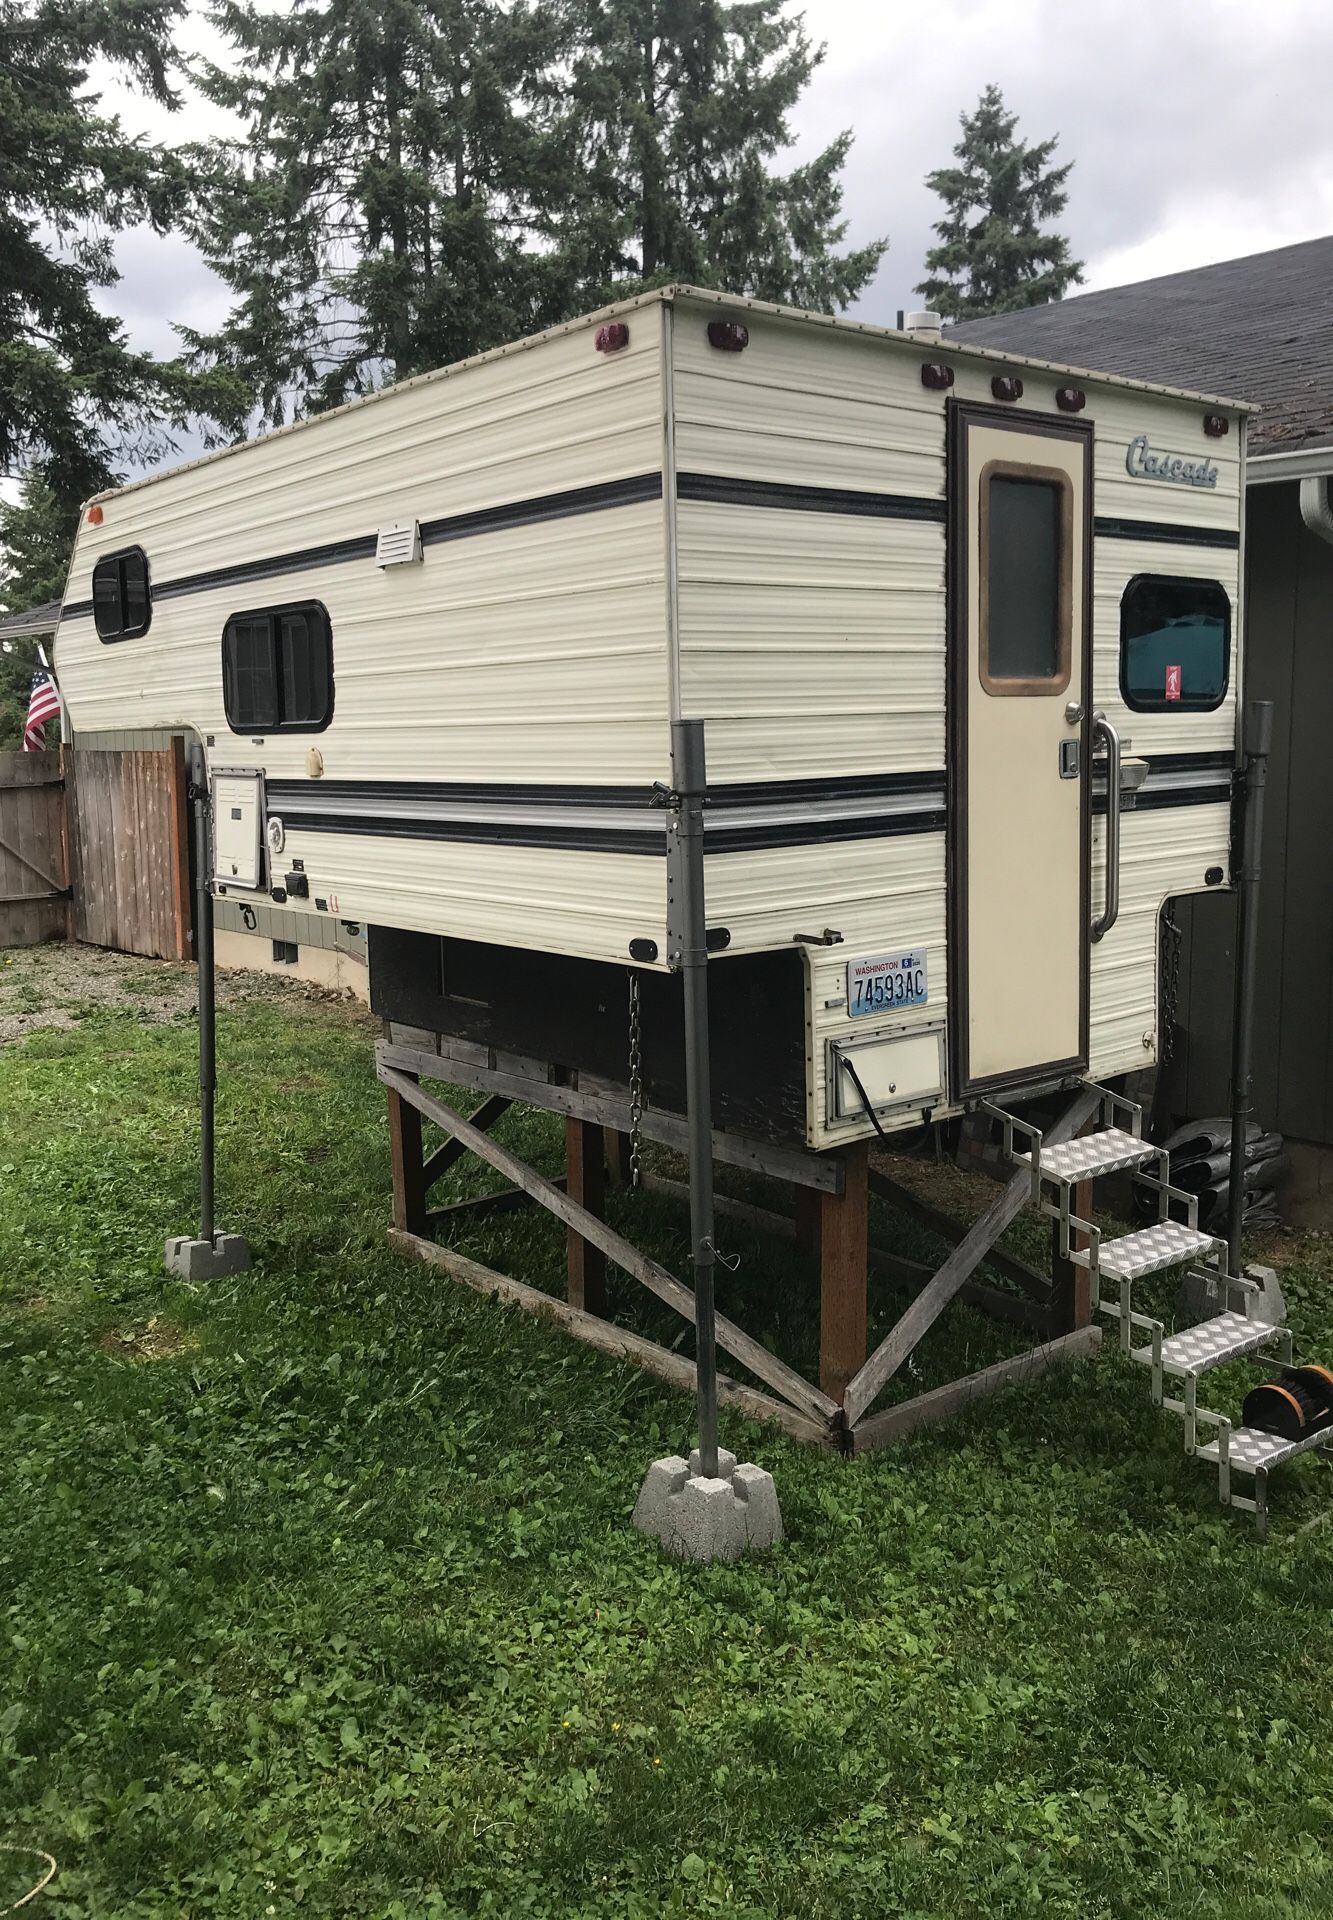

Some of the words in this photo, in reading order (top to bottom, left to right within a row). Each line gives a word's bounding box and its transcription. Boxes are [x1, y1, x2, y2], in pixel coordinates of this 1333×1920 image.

[1126, 435, 1218, 488] Cascade
[855, 961, 899, 976] WASHINGTON
[854, 969, 924, 1008] 74593AC
[871, 1002, 896, 1011] EVERGREEN
